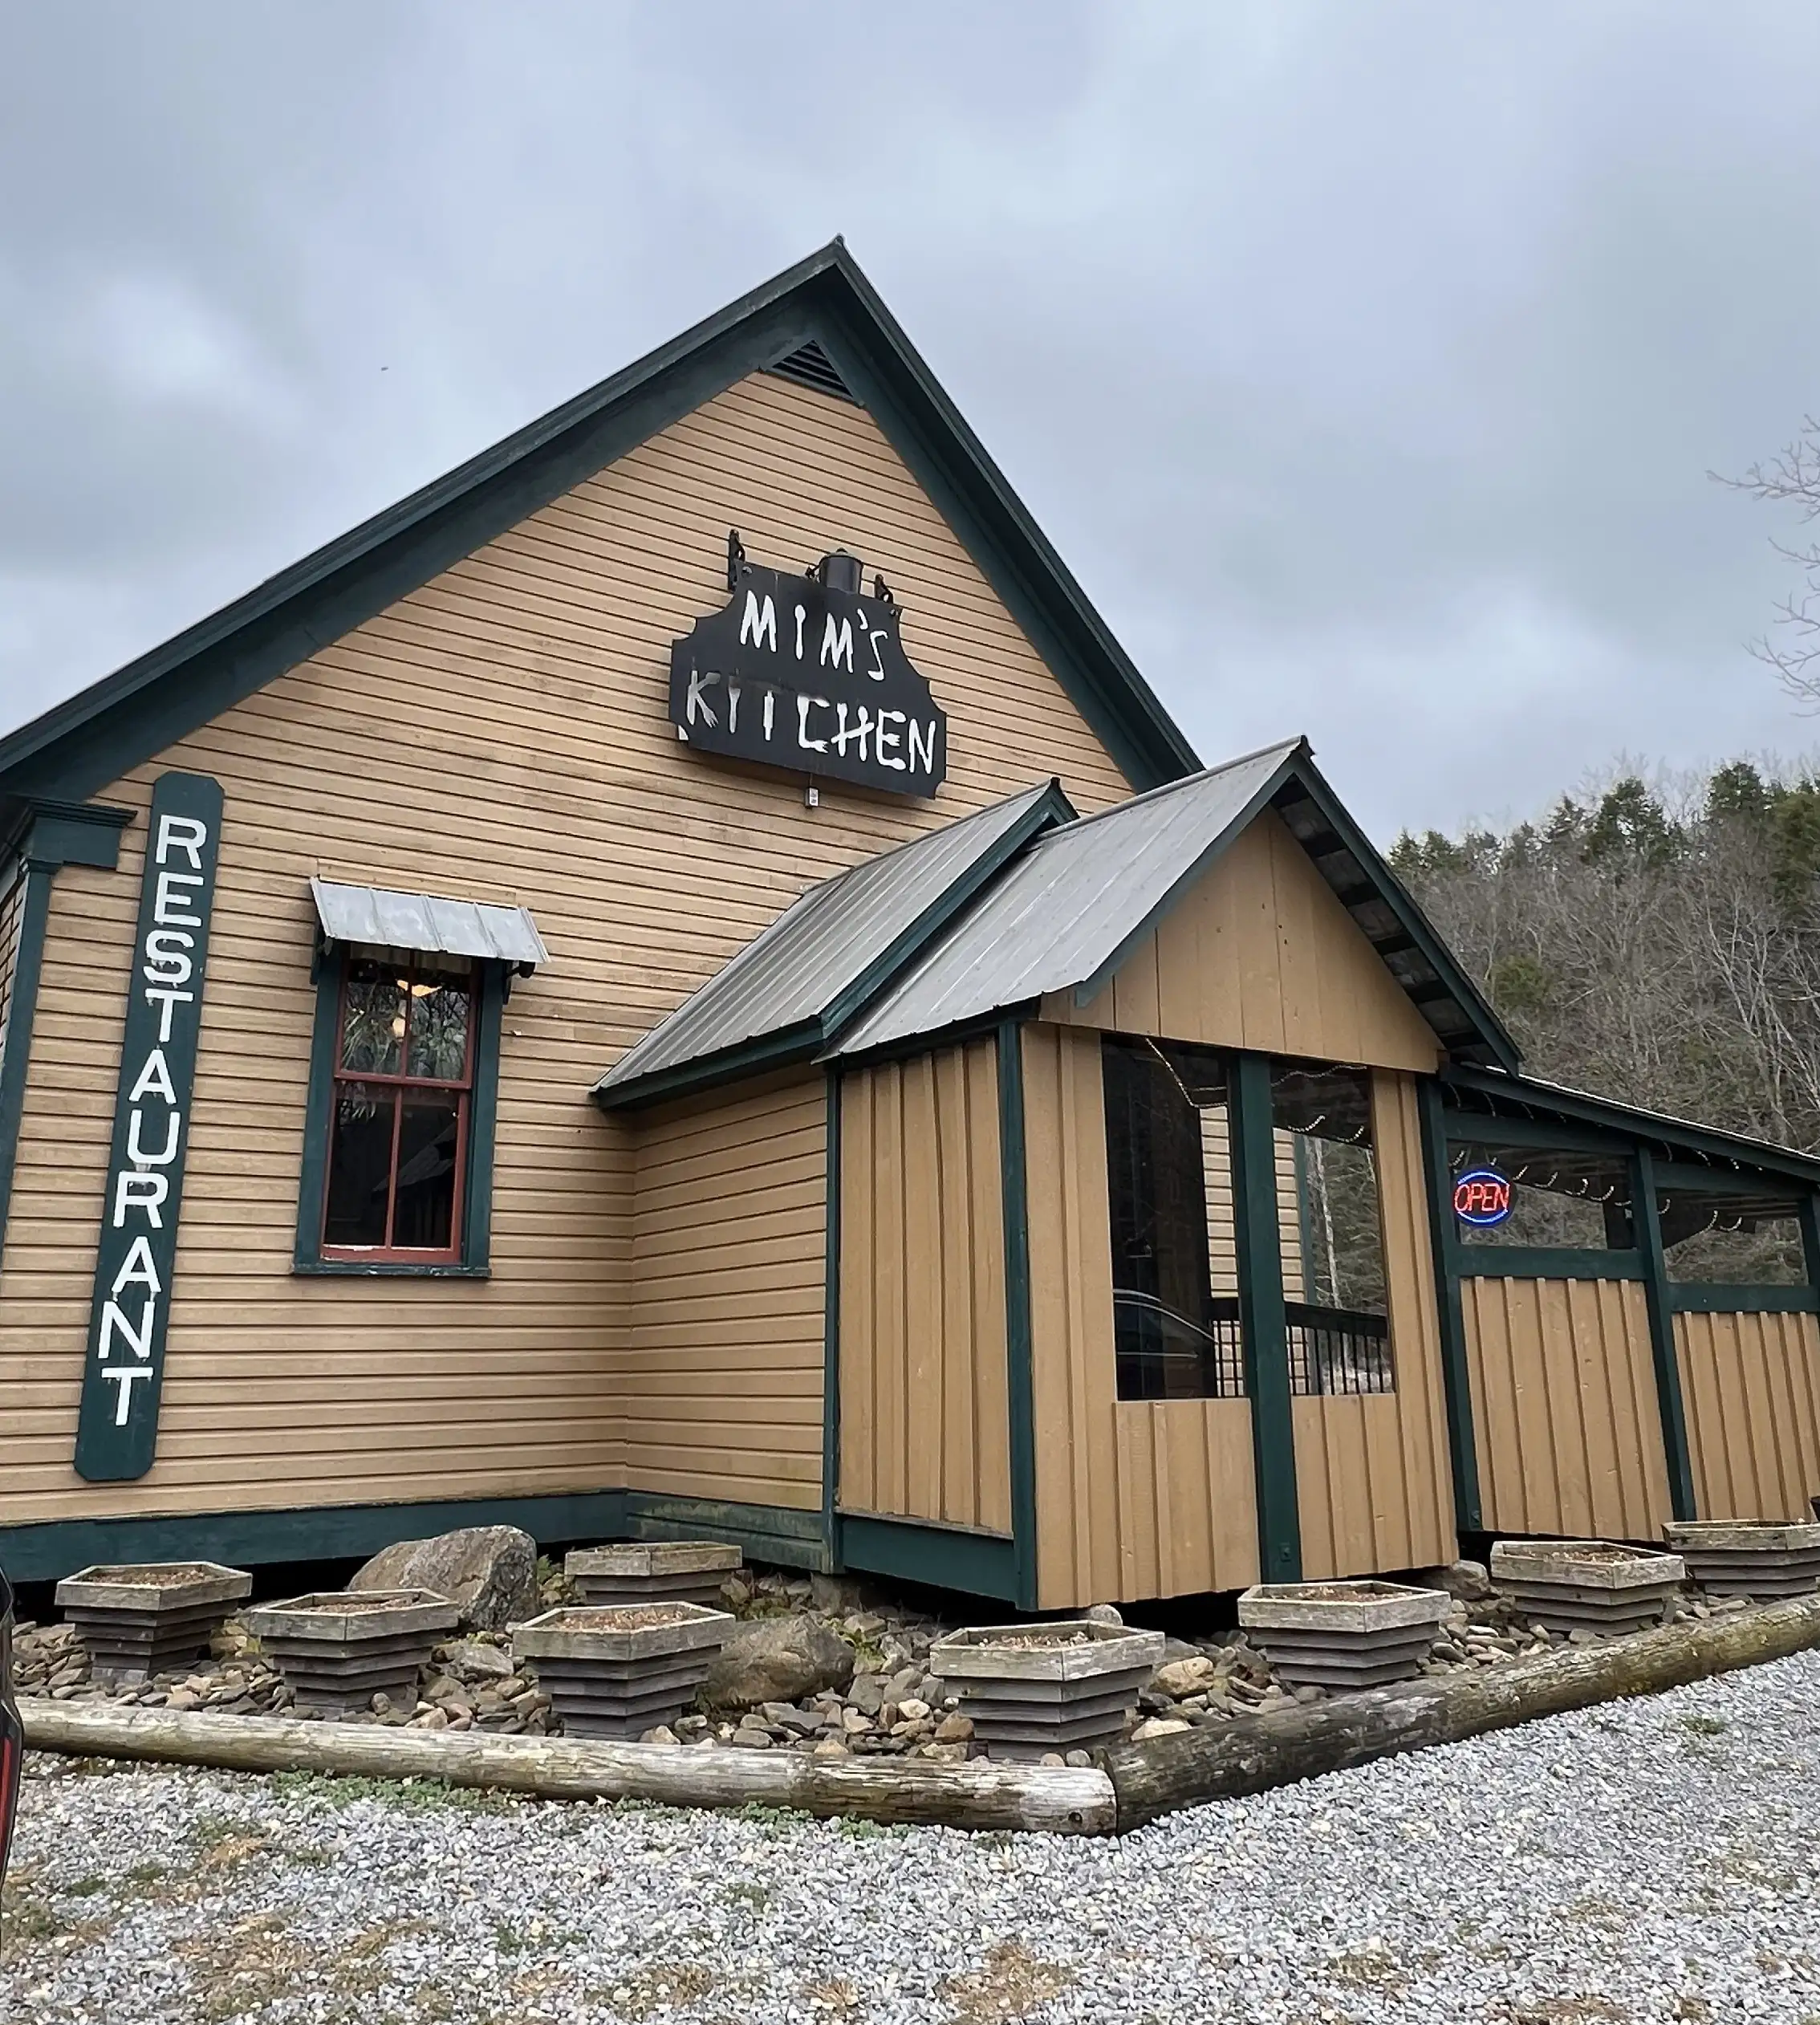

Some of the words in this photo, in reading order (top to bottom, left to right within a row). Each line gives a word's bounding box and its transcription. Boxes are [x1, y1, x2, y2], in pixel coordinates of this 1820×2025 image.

[740, 590, 888, 681] MIM'S
[686, 668, 936, 775] KITCHEN
[97, 814, 208, 1427] RESTAURANT
[1454, 1182, 1510, 1212] OPEN
